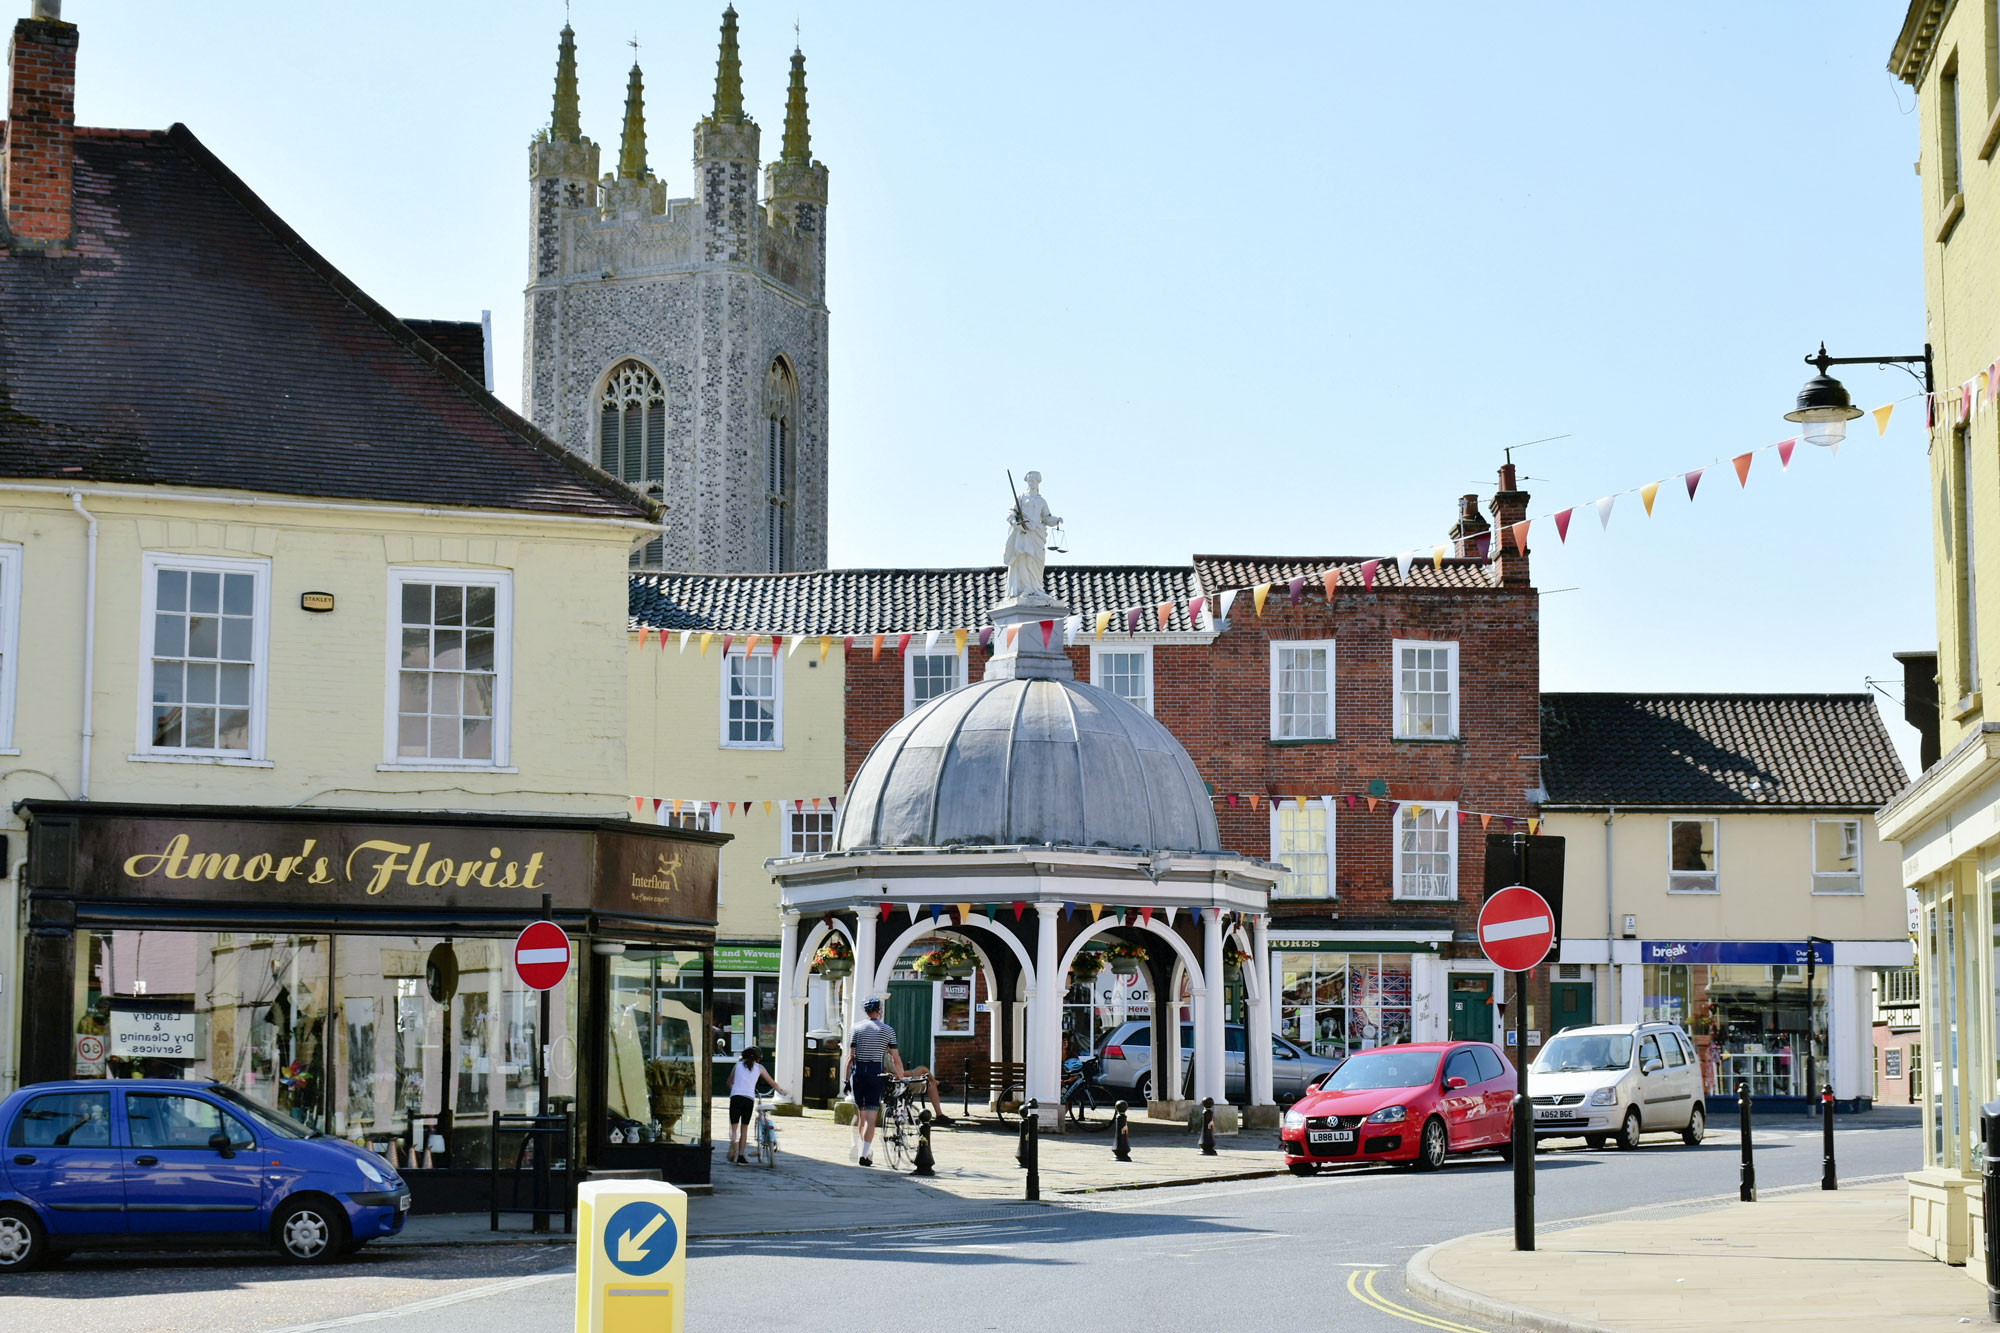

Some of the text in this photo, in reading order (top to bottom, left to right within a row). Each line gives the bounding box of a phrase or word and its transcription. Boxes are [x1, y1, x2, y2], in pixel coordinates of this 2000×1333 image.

[123, 833, 544, 896] Amor's Florist
[631, 872, 671, 890] Interflora
[1267, 939, 1320, 948] TORES
[721, 949, 741, 957] and
[742, 949, 781, 959] Wavene
[1652, 943, 1688, 958] break
[1455, 1002, 1463, 1010] 21
[1559, 1110, 1573, 1118] BGE
[1313, 1132, 1350, 1142] L888 LDJ
